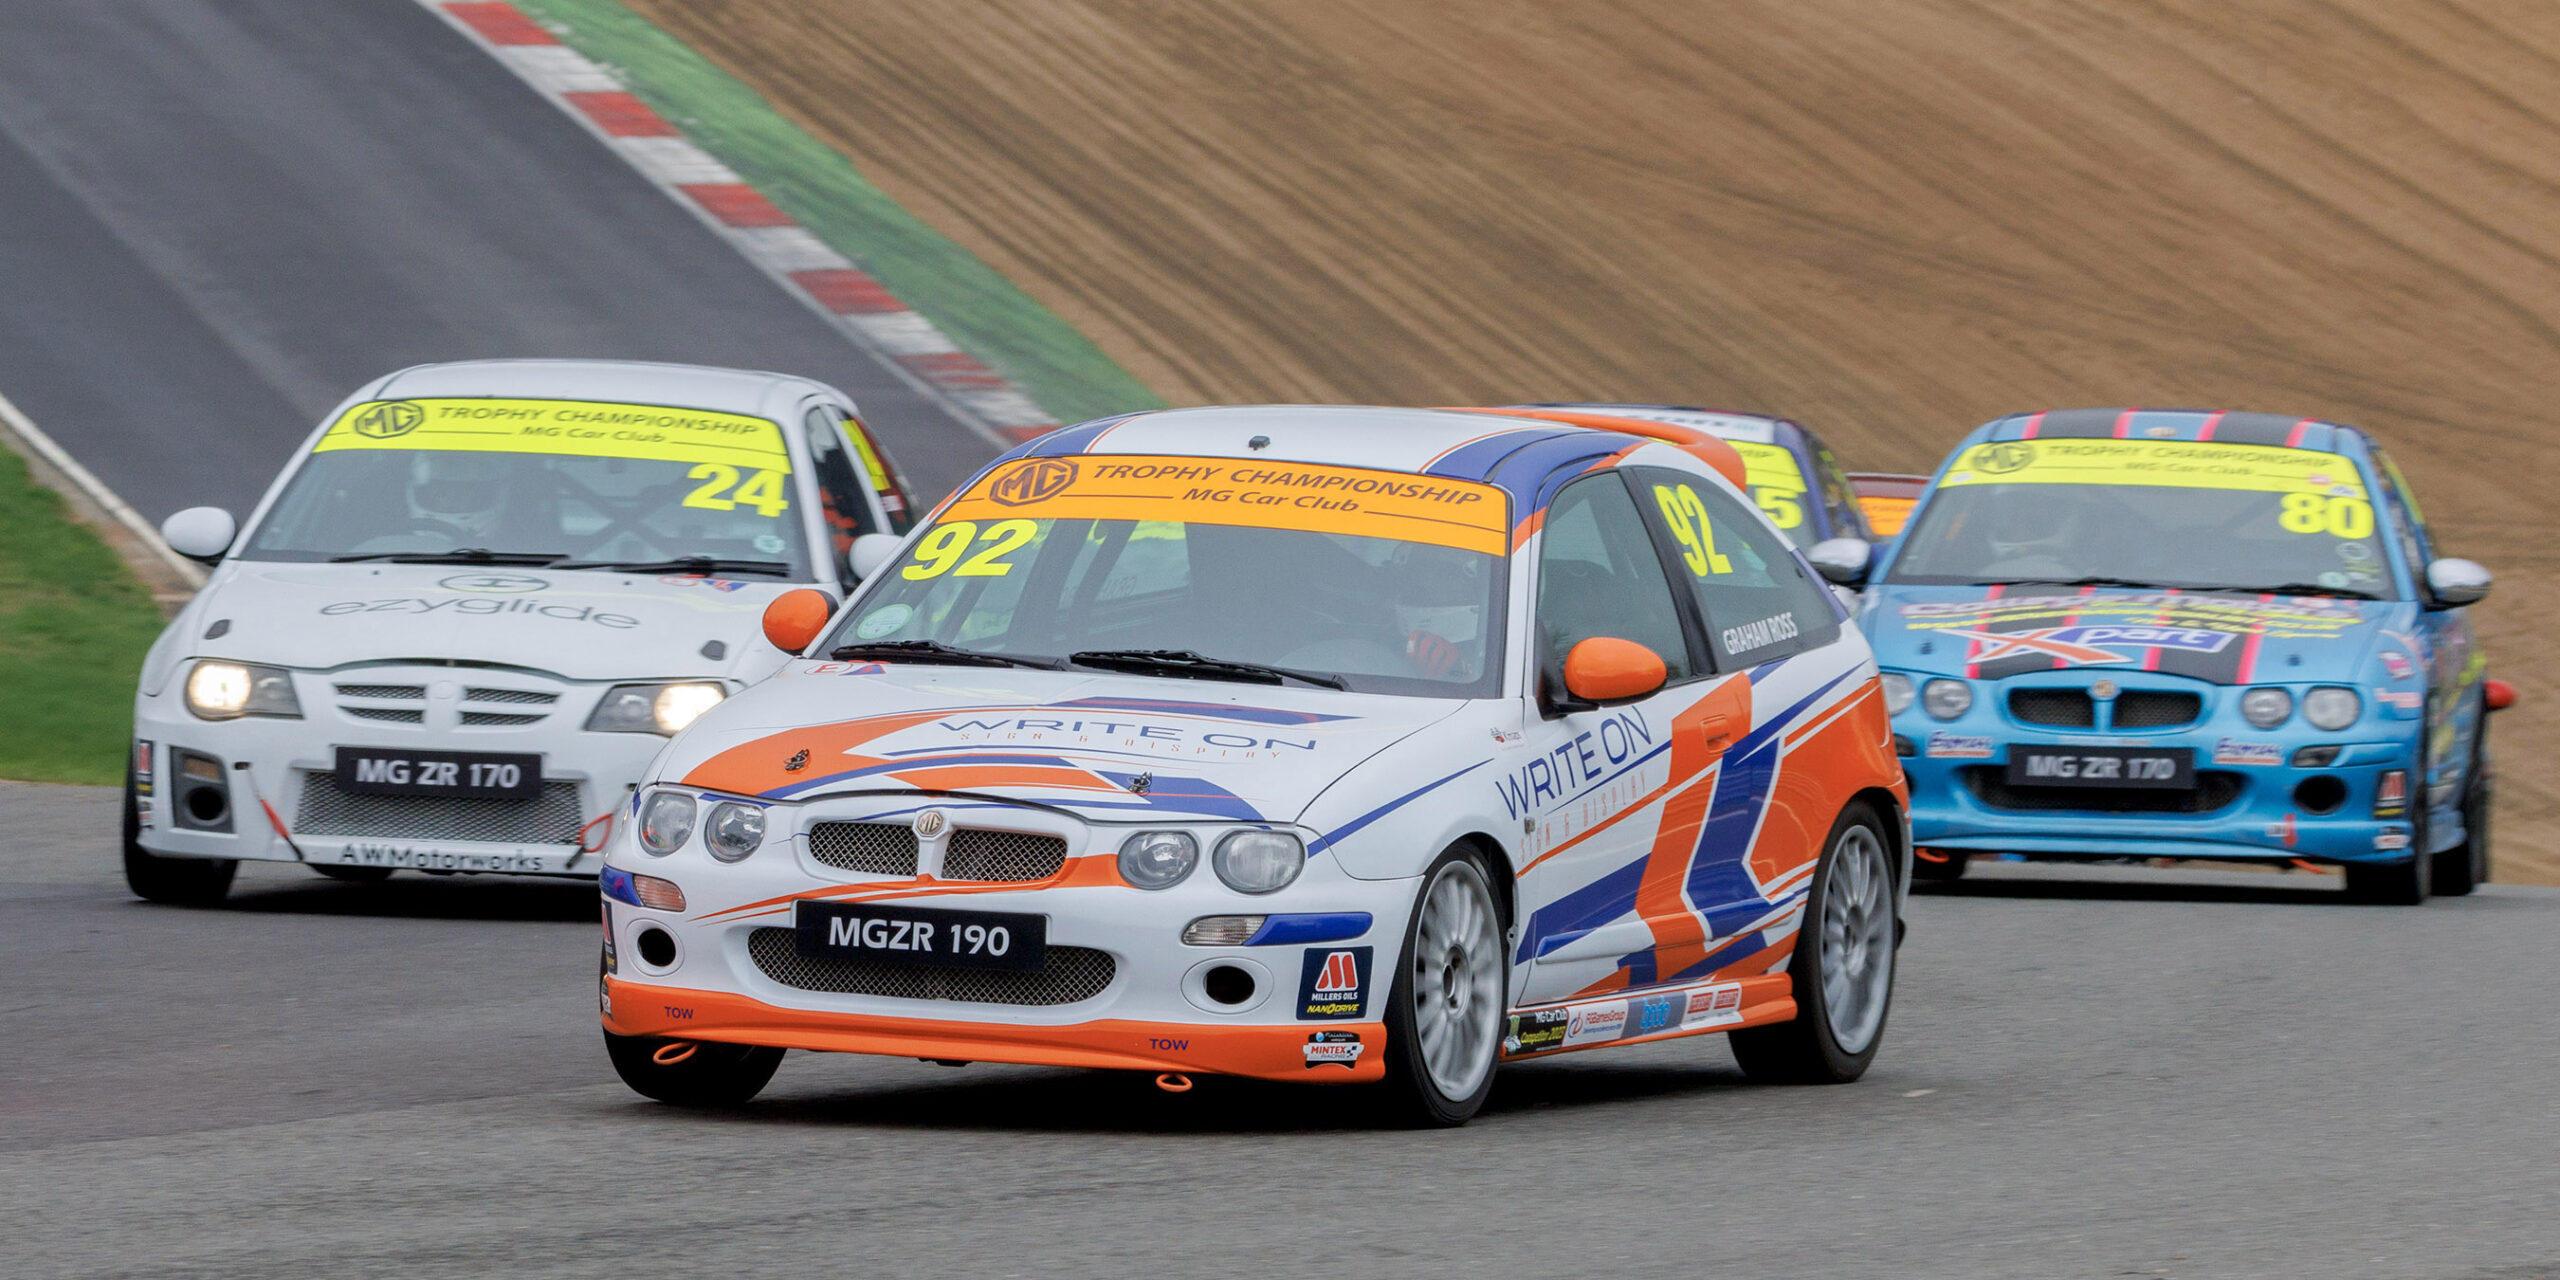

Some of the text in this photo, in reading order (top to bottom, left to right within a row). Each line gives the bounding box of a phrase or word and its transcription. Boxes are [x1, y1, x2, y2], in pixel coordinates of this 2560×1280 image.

[360, 403, 418, 435] MG
[439, 406, 760, 435] TROPHY CHAMPIONSHIP
[520, 426, 666, 443] MG Car Club
[681, 462, 789, 518] 24
[997, 460, 1070, 501] MG
[1093, 464, 1483, 505] TROPHY CHAMPIONSHIP
[1182, 487, 1360, 512] MG Car Club
[2278, 491, 2374, 539] 80
[1653, 484, 1733, 577] 92
[901, 519, 1038, 581] 92
[319, 598, 641, 629] ezyglide
[1722, 612, 1799, 655] GRAHAM ROSS
[938, 719, 1317, 752] WRITE ON
[356, 757, 521, 789] MG ZR 170
[1495, 705, 1652, 822] WRITE ON
[2025, 754, 2177, 780] MG ZR 170
[920, 811, 943, 833] MG
[828, 915, 1011, 957] MGZR 190
[663, 1006, 694, 1019] TOW
[1311, 991, 1358, 1002] MILLERS OILS
[1149, 1038, 1189, 1051] TOW
[1310, 1046, 1347, 1055] MINTEX
